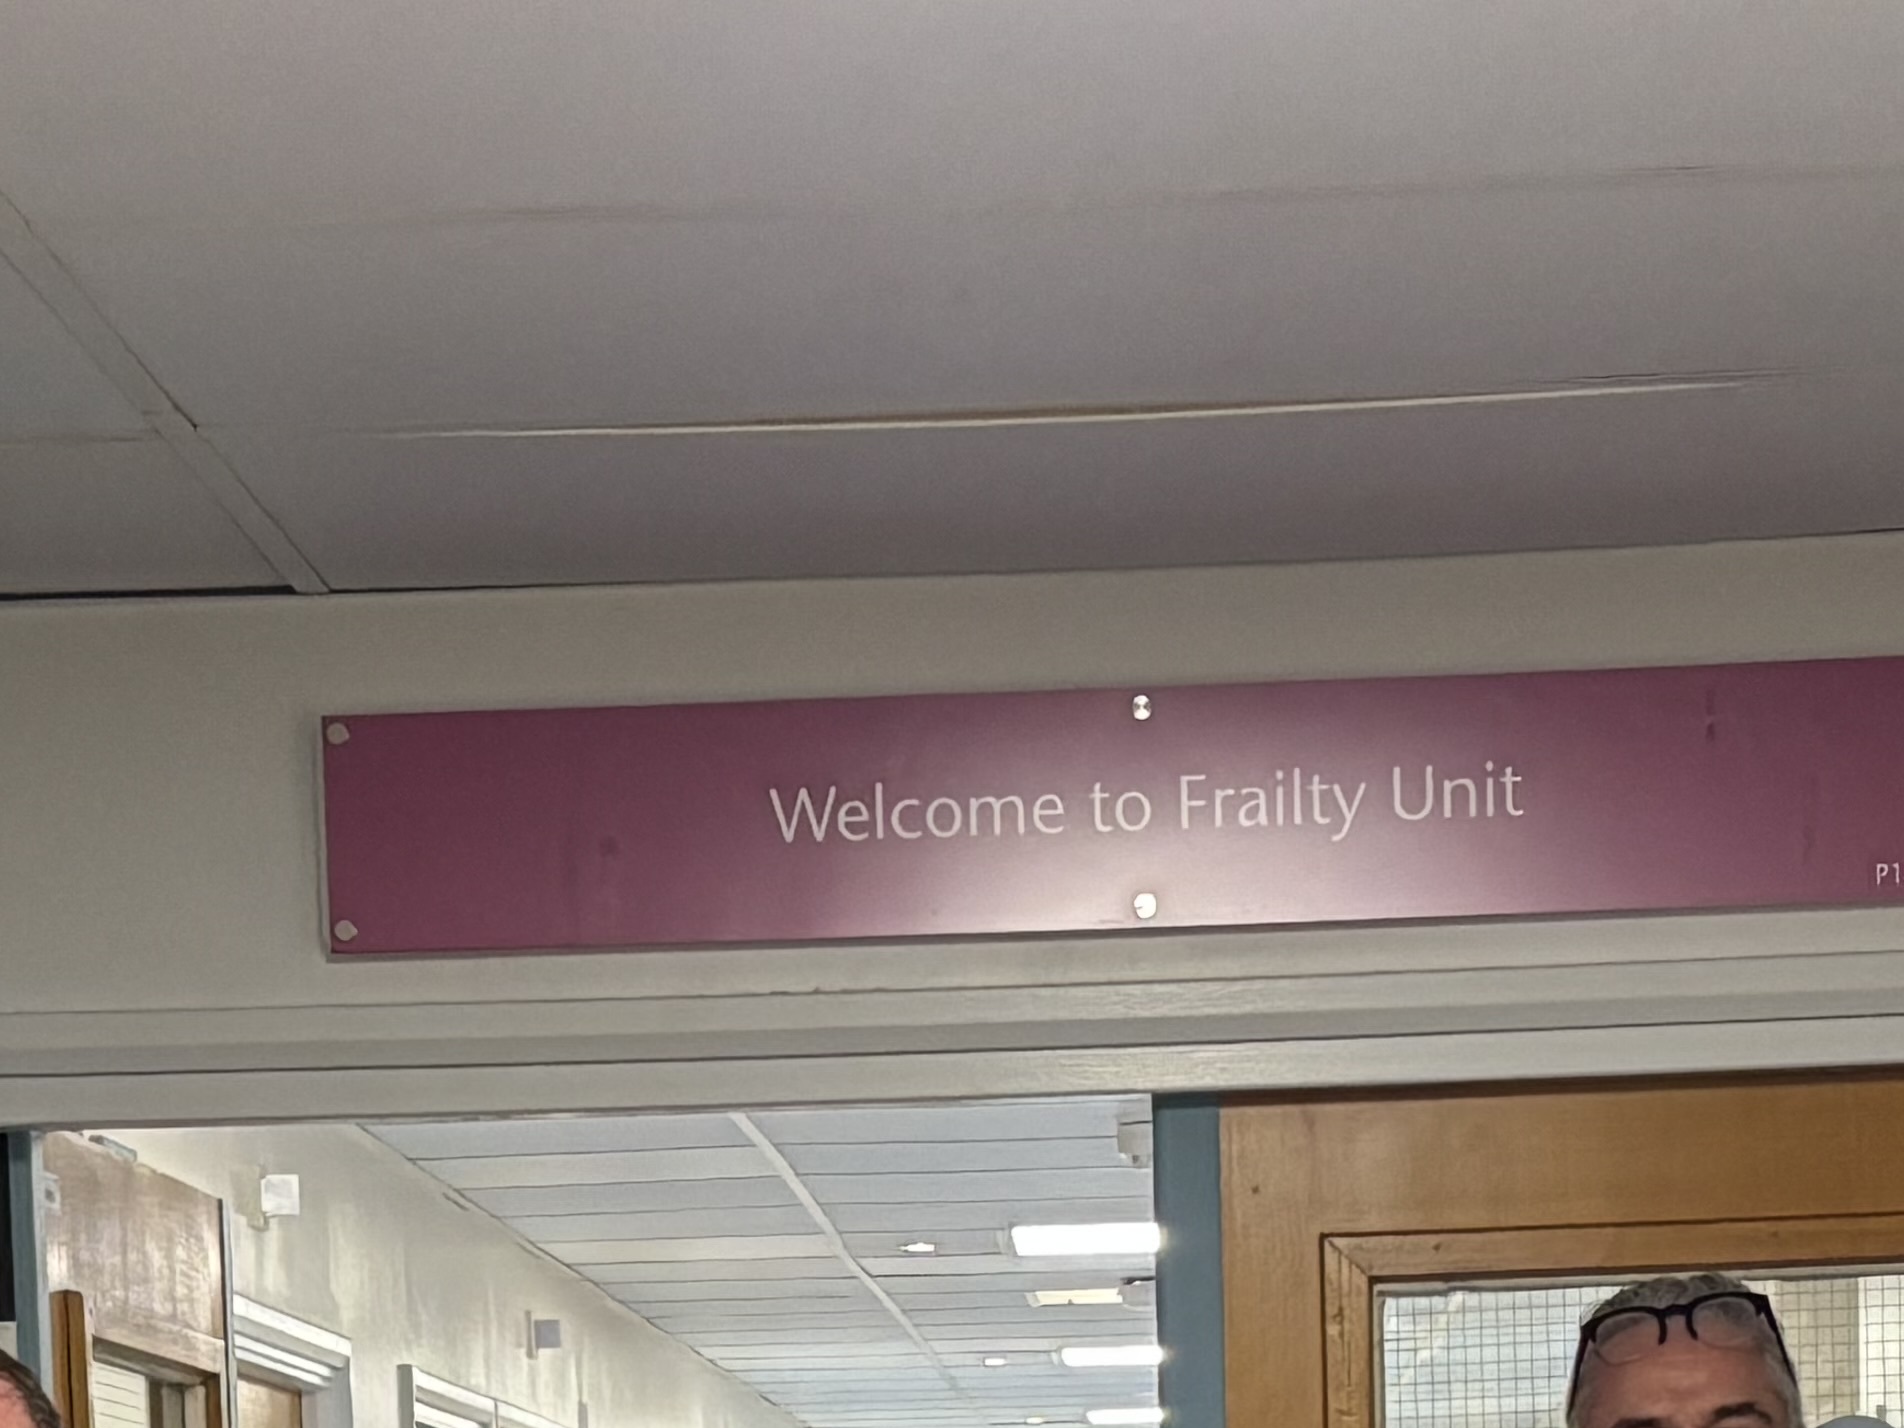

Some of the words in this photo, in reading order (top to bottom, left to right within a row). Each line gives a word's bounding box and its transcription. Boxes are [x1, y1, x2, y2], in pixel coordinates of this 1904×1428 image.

[769, 782, 1065, 843] Welcome
[1089, 782, 1151, 832] to
[1180, 767, 1367, 842] Frailty
[1393, 760, 1524, 820] Unit
